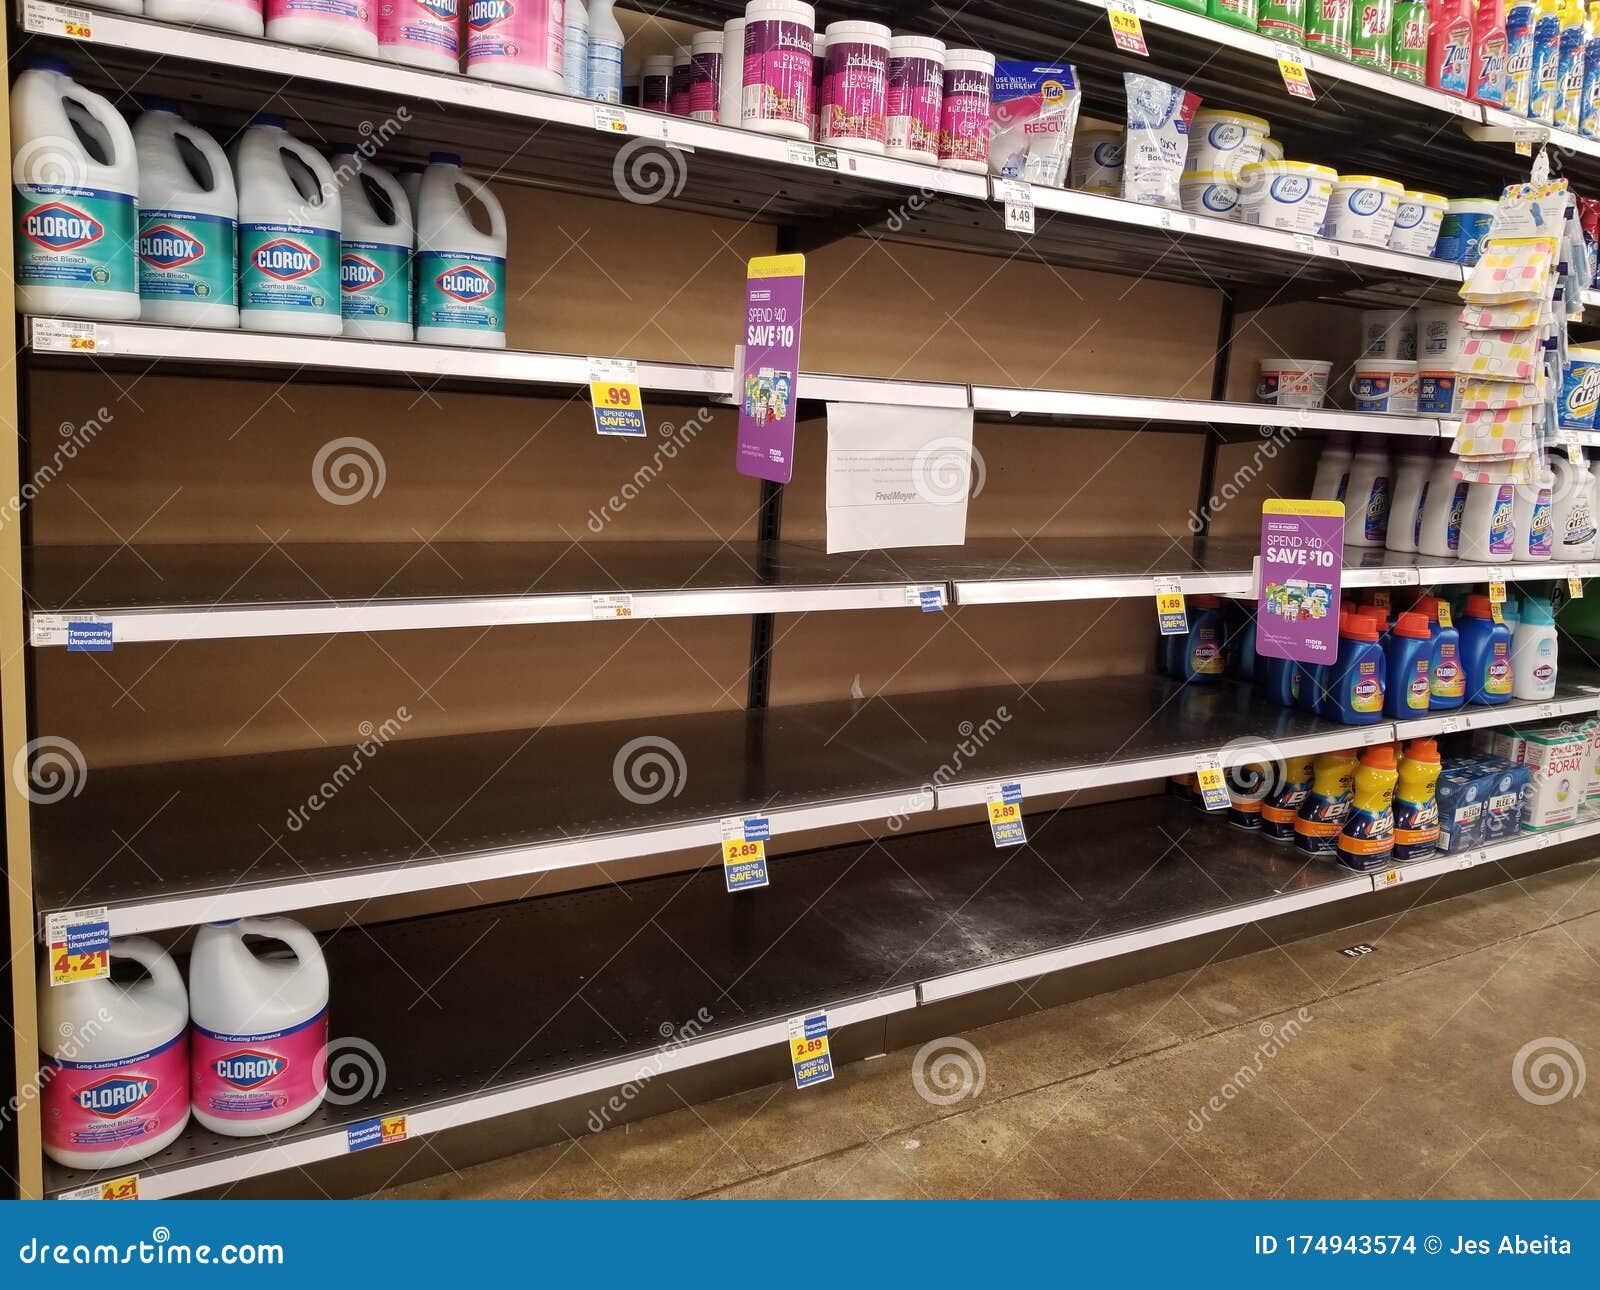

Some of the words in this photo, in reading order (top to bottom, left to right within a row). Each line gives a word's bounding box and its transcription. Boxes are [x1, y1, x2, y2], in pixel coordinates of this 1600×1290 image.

[66, 25, 91, 37] 2.49
[1043, 86, 1064, 98] Tide
[1011, 208, 1030, 222] 4.49
[27, 216, 93, 240] CLOROX
[140, 237, 194, 258] CLOROX
[31, 254, 58, 262] Scented
[60, 255, 87, 264] Bleach
[257, 250, 312, 271] CLOROX
[342, 265, 375, 282] OROX
[443, 275, 489, 294] CLOROX
[748, 307, 773, 322] SPEND
[774, 307, 787, 322] $40
[71, 338, 95, 349] 2.49
[747, 325, 775, 347] SAVE
[776, 325, 794, 348] $10
[605, 387, 631, 406] .99
[600, 416, 626, 427] SAVE
[626, 418, 641, 428] $10
[1267, 535, 1302, 548] SPEND
[1304, 536, 1322, 549] $40
[1266, 547, 1307, 565] SAVE
[1309, 551, 1334, 567] $10
[1161, 599, 1180, 609] 1.69
[69, 630, 112, 638] Temporarily
[1306, 638, 1322, 646] more
[1548, 758, 1582, 778] BORAX
[993, 806, 1015, 818] 2.89
[729, 843, 758, 858] 2.89
[730, 871, 752, 883] SAVE
[752, 869, 764, 878] $10
[732, 865, 751, 873] SPEND
[67, 929, 109, 941] Temporarily
[68, 938, 109, 949] Unavailable
[54, 950, 108, 974] 4.21
[215, 1033, 251, 1042] Long-Lasting
[251, 1033, 281, 1042] Fragrance
[796, 1039, 822, 1056] 2.89
[76, 1061, 118, 1070] Long-Lasting
[119, 1053, 151, 1065] Fragrance
[217, 1058, 278, 1079] CLOROX
[800, 1061, 817, 1070] SPEND
[798, 1067, 818, 1080] SAVE
[818, 1063, 829, 1073] $10
[80, 1080, 149, 1109] CLOROX
[248, 1091, 270, 1099] Bleach
[88, 1121, 115, 1130] Scented
[117, 1116, 140, 1126] Bleach
[349, 1125, 380, 1138] Temporarily
[349, 1133, 381, 1145] Unavailable
[103, 1182, 137, 1200] 4.21
